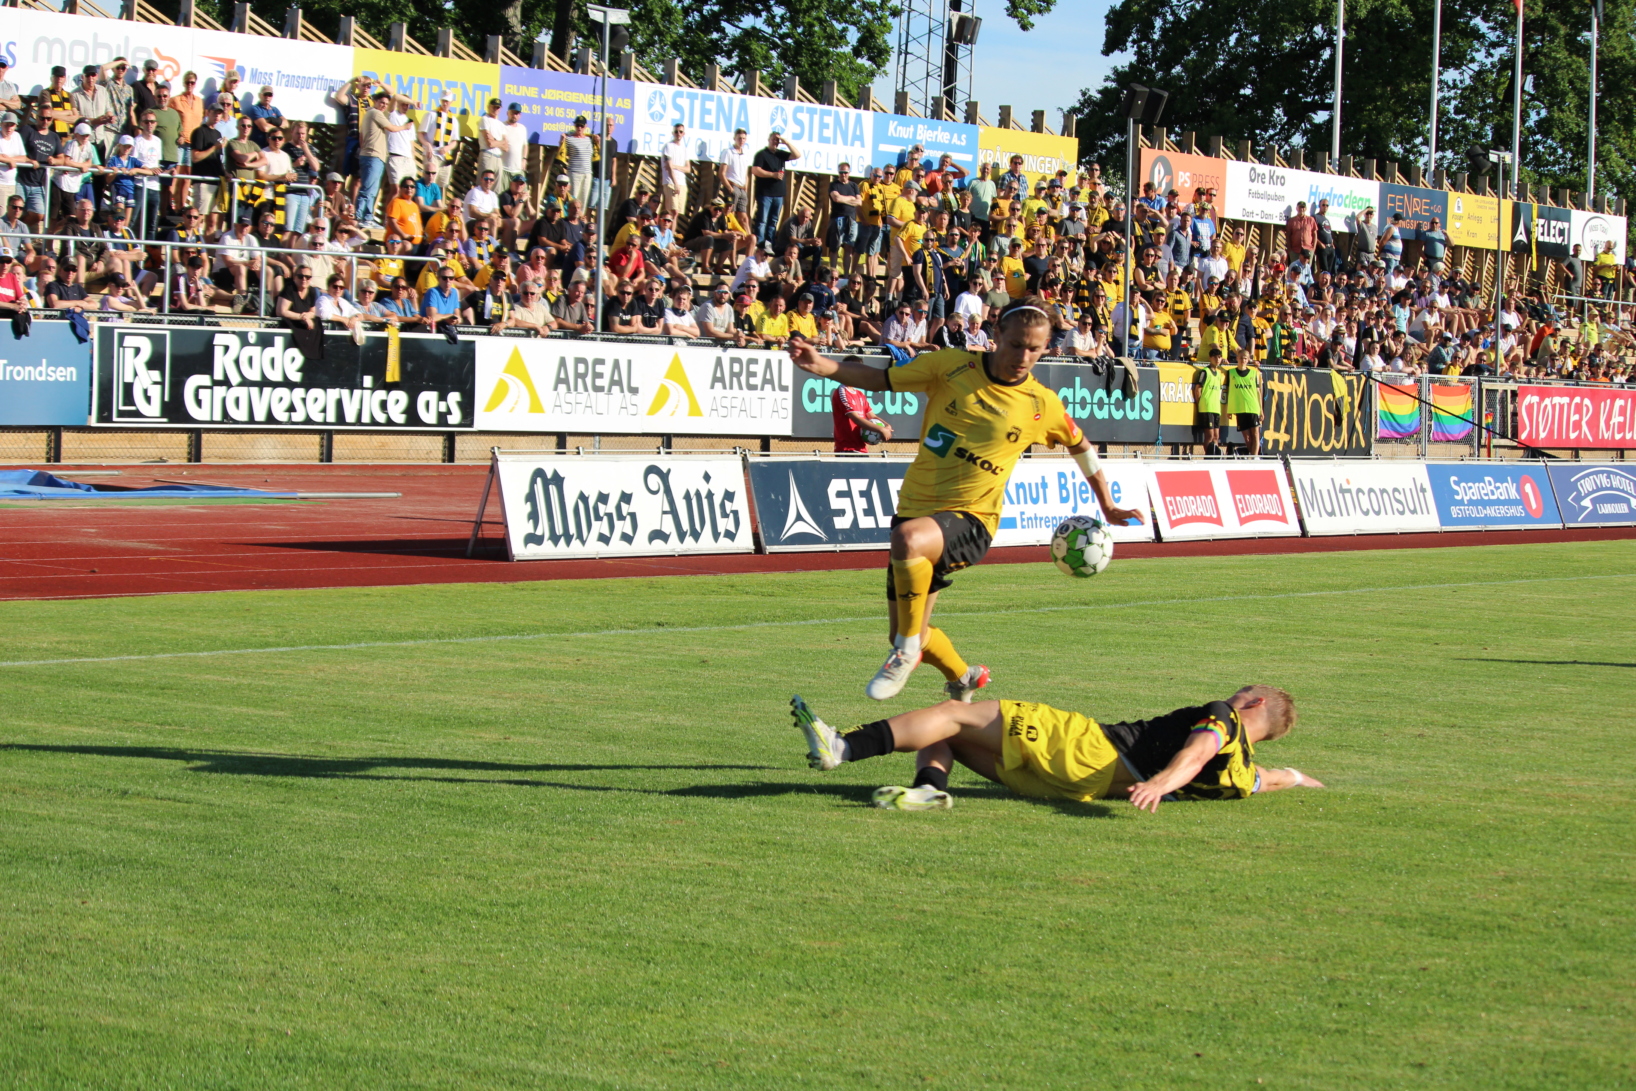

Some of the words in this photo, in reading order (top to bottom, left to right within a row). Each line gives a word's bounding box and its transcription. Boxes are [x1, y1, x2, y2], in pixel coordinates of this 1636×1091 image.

[249, 67, 273, 86] Moss
[505, 84, 539, 98] RUNE
[541, 89, 613, 107] JØRGENSEN
[615, 98, 632, 110] AS
[670, 89, 751, 135] STENA
[791, 105, 866, 149] STENA
[888, 120, 914, 139] Knut
[916, 124, 950, 145] Bjerke
[642, 131, 750, 159] REYCLI
[978, 145, 1060, 175] KRÅKINGEN
[1178, 170, 1191, 188] PS
[1191, 172, 1220, 191] PRESS
[1248, 166, 1266, 185] Øre
[1268, 169, 1286, 187] Kro
[1248, 188, 1286, 203] Fotballpuben
[1307, 183, 1372, 210] Hydroclean
[1387, 193, 1431, 218] FENRE
[1241, 208, 1255, 219] Dart
[1260, 210, 1274, 221] Dans
[1467, 212, 1483, 224] Anlegg
[1466, 229, 1478, 239] Kran
[1531, 217, 1570, 247] ELECT
[0, 360, 77, 383] Trondsen
[212, 331, 303, 387] Råde
[552, 356, 640, 394] AREAL
[709, 356, 790, 393] AREAL
[183, 375, 408, 425] Graveservice
[551, 391, 612, 415] ASFALT
[618, 393, 639, 416] AS
[709, 396, 765, 419] ASFALT
[770, 397, 790, 420] AS
[801, 376, 919, 416] abcus
[1059, 376, 1154, 421] abacus
[1520, 393, 1593, 443] STØTTER
[1598, 397, 1636, 441] KÆL
[953, 447, 1002, 476] SKOL
[1057, 470, 1122, 515] Bjee
[1298, 477, 1431, 518] Multiconsult
[1449, 475, 1521, 504] SpareBank
[1577, 473, 1611, 497] STØTVIG
[1610, 474, 1636, 497] HOTEL
[523, 467, 639, 549] Moss
[643, 464, 741, 545] Avis
[1165, 494, 1218, 521] ELDORADO
[1235, 493, 1283, 518] ELDORADO
